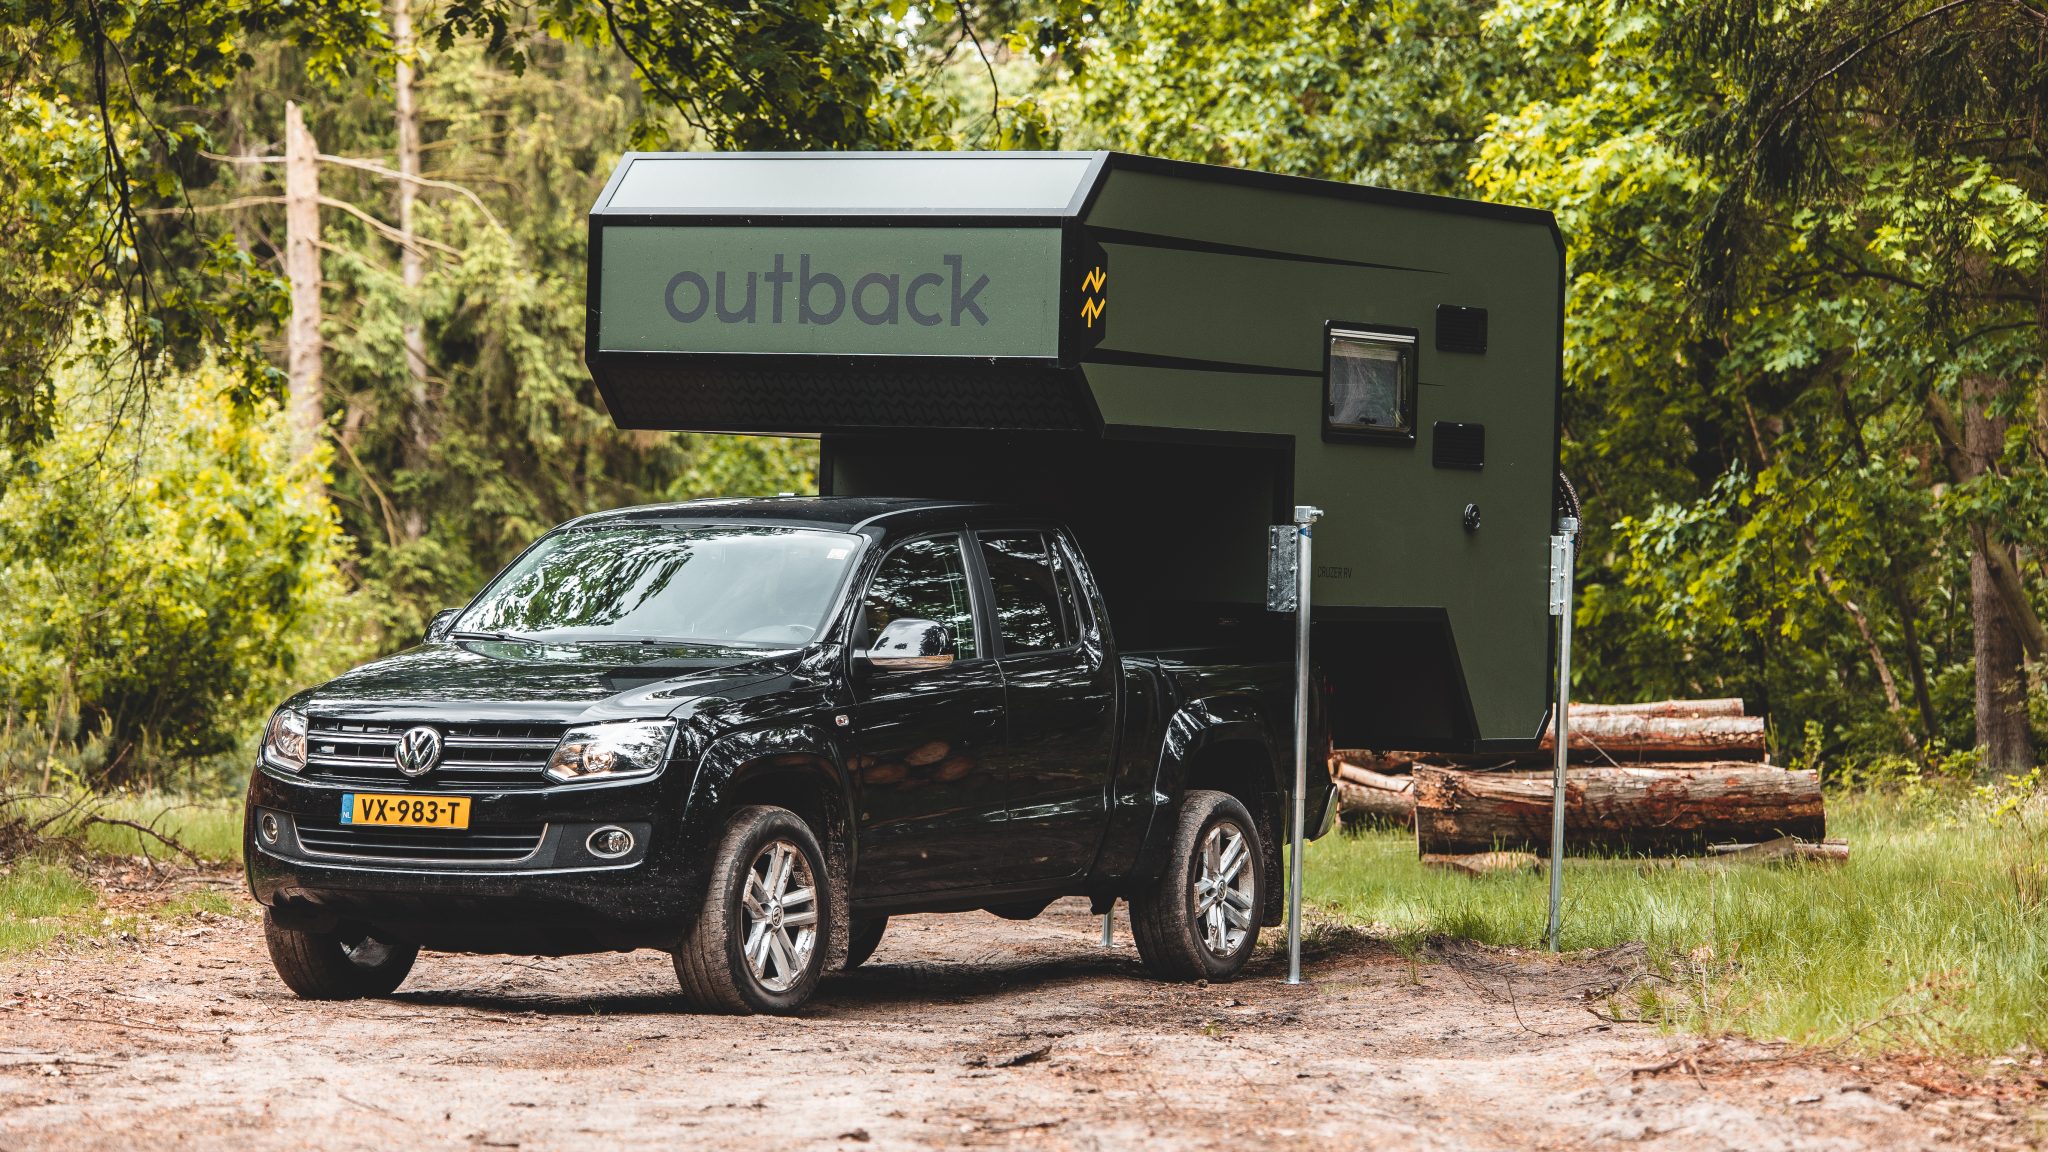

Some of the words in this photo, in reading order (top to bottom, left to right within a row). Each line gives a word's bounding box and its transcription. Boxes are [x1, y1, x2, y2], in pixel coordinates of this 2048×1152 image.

[664, 253, 990, 327] outback
[1317, 566, 1342, 579] CRUZER
[1343, 567, 1352, 579] RV
[361, 798, 460, 824] VX-983-T
